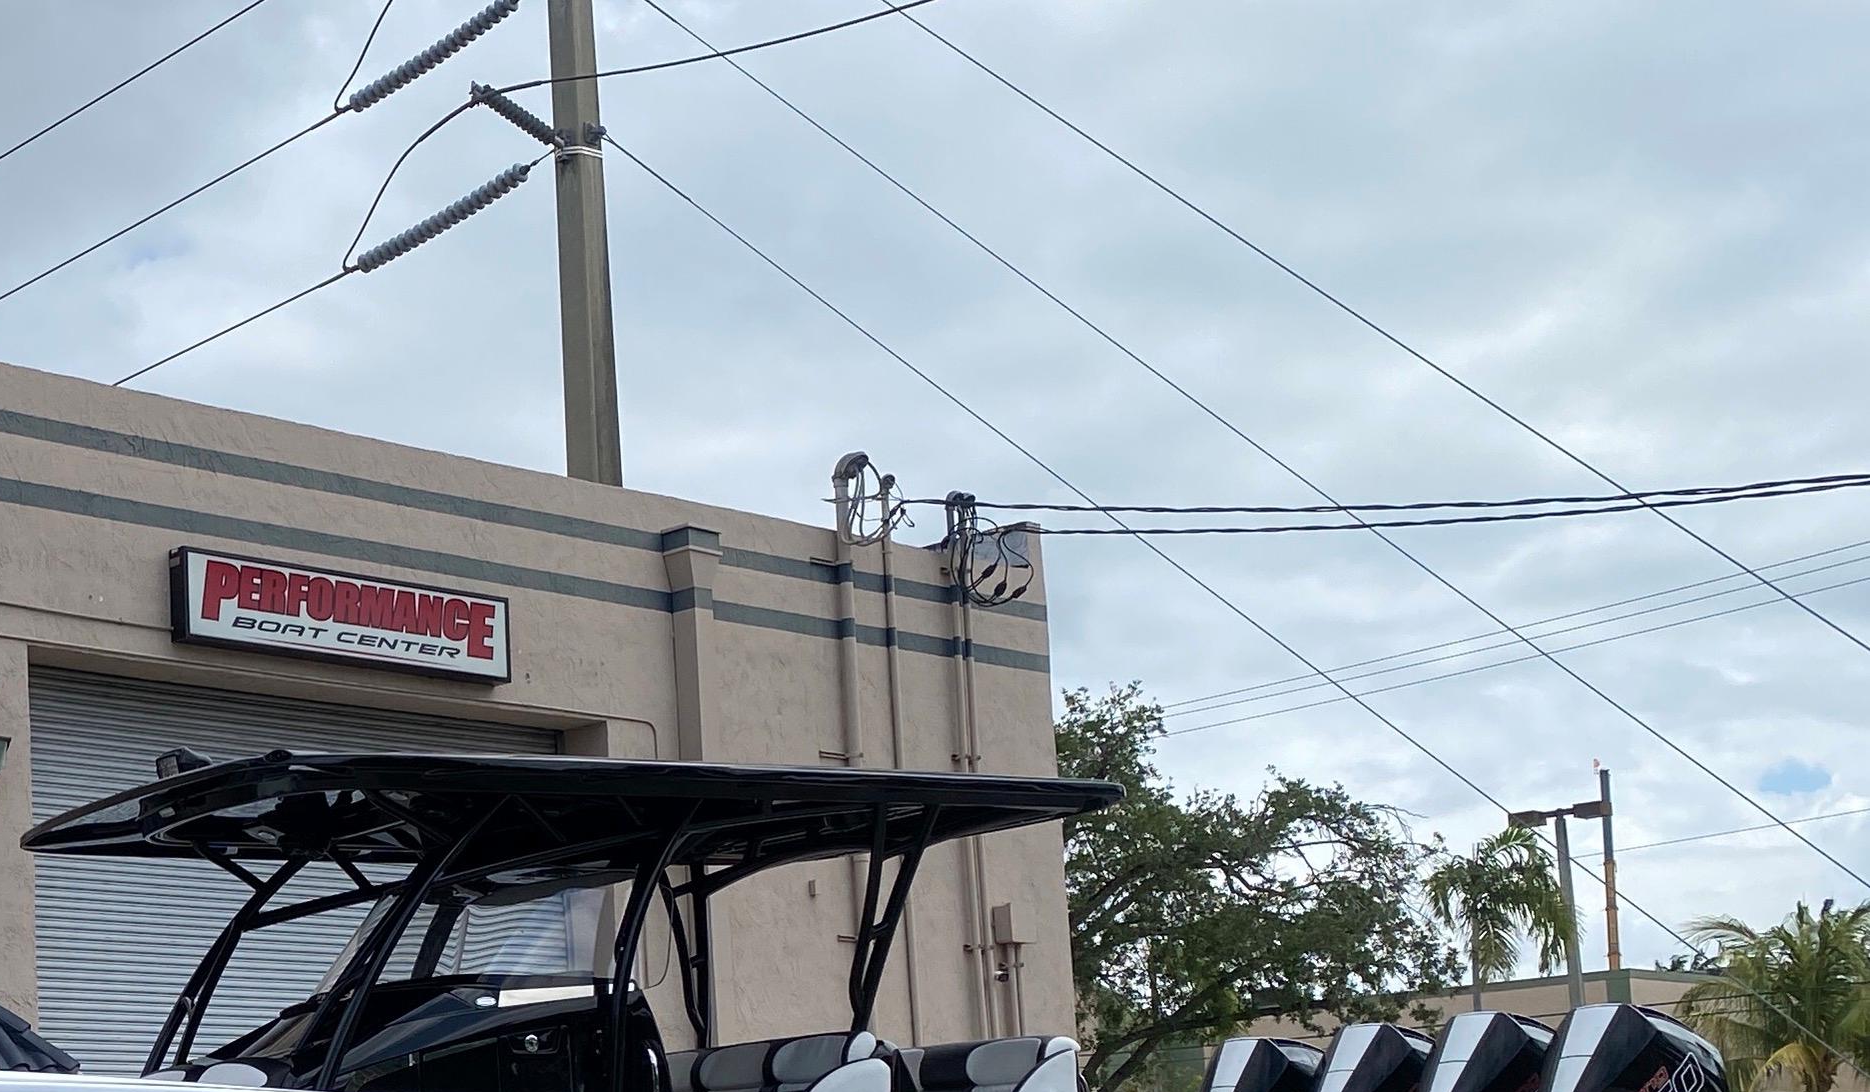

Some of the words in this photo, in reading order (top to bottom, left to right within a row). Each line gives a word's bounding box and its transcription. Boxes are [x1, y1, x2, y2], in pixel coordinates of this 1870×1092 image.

[201, 559, 496, 660] PERFORMANCE
[232, 615, 330, 640] BOAT
[335, 631, 461, 659] CENTER
